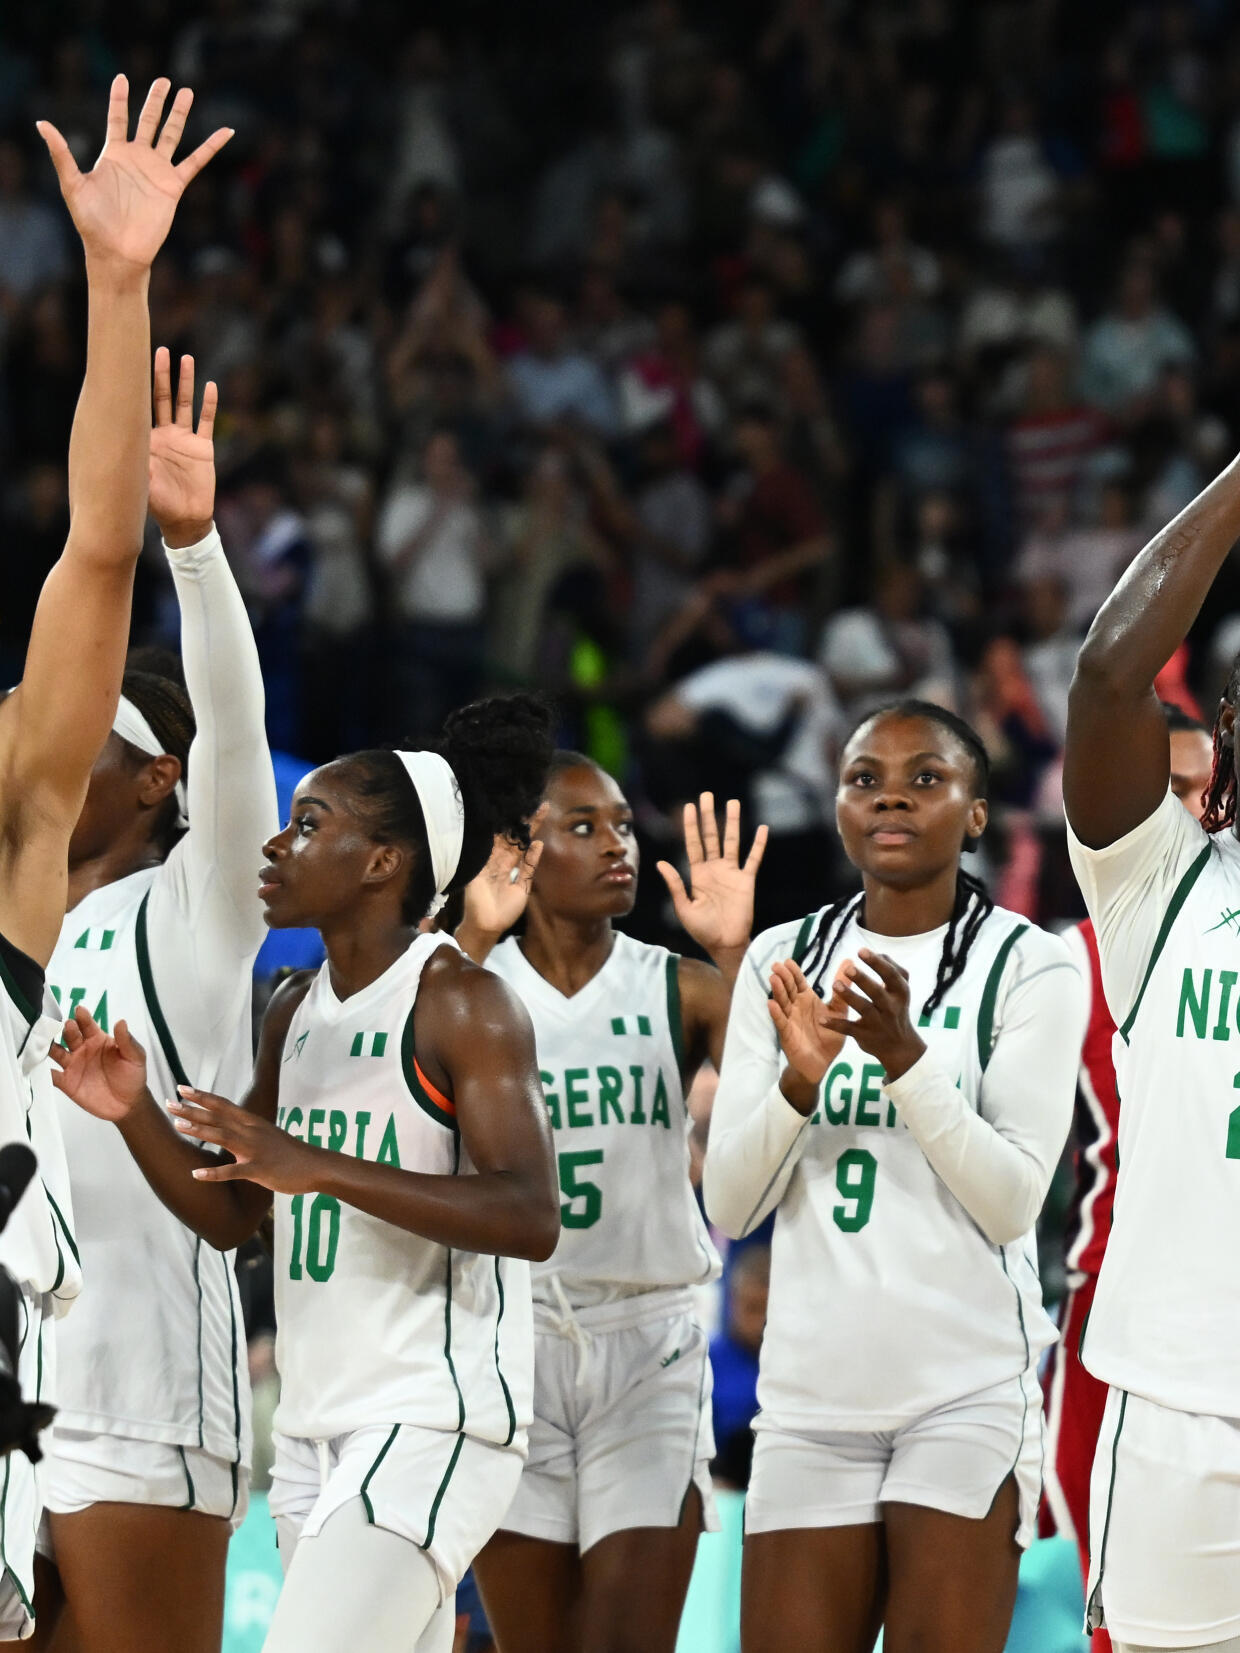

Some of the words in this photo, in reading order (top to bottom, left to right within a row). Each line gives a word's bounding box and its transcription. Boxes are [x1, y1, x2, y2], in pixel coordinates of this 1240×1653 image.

[540, 1065, 671, 1129] GERIA
[558, 1149, 604, 1229] 5
[832, 1148, 878, 1233] 9
[289, 1192, 341, 1283] 10
